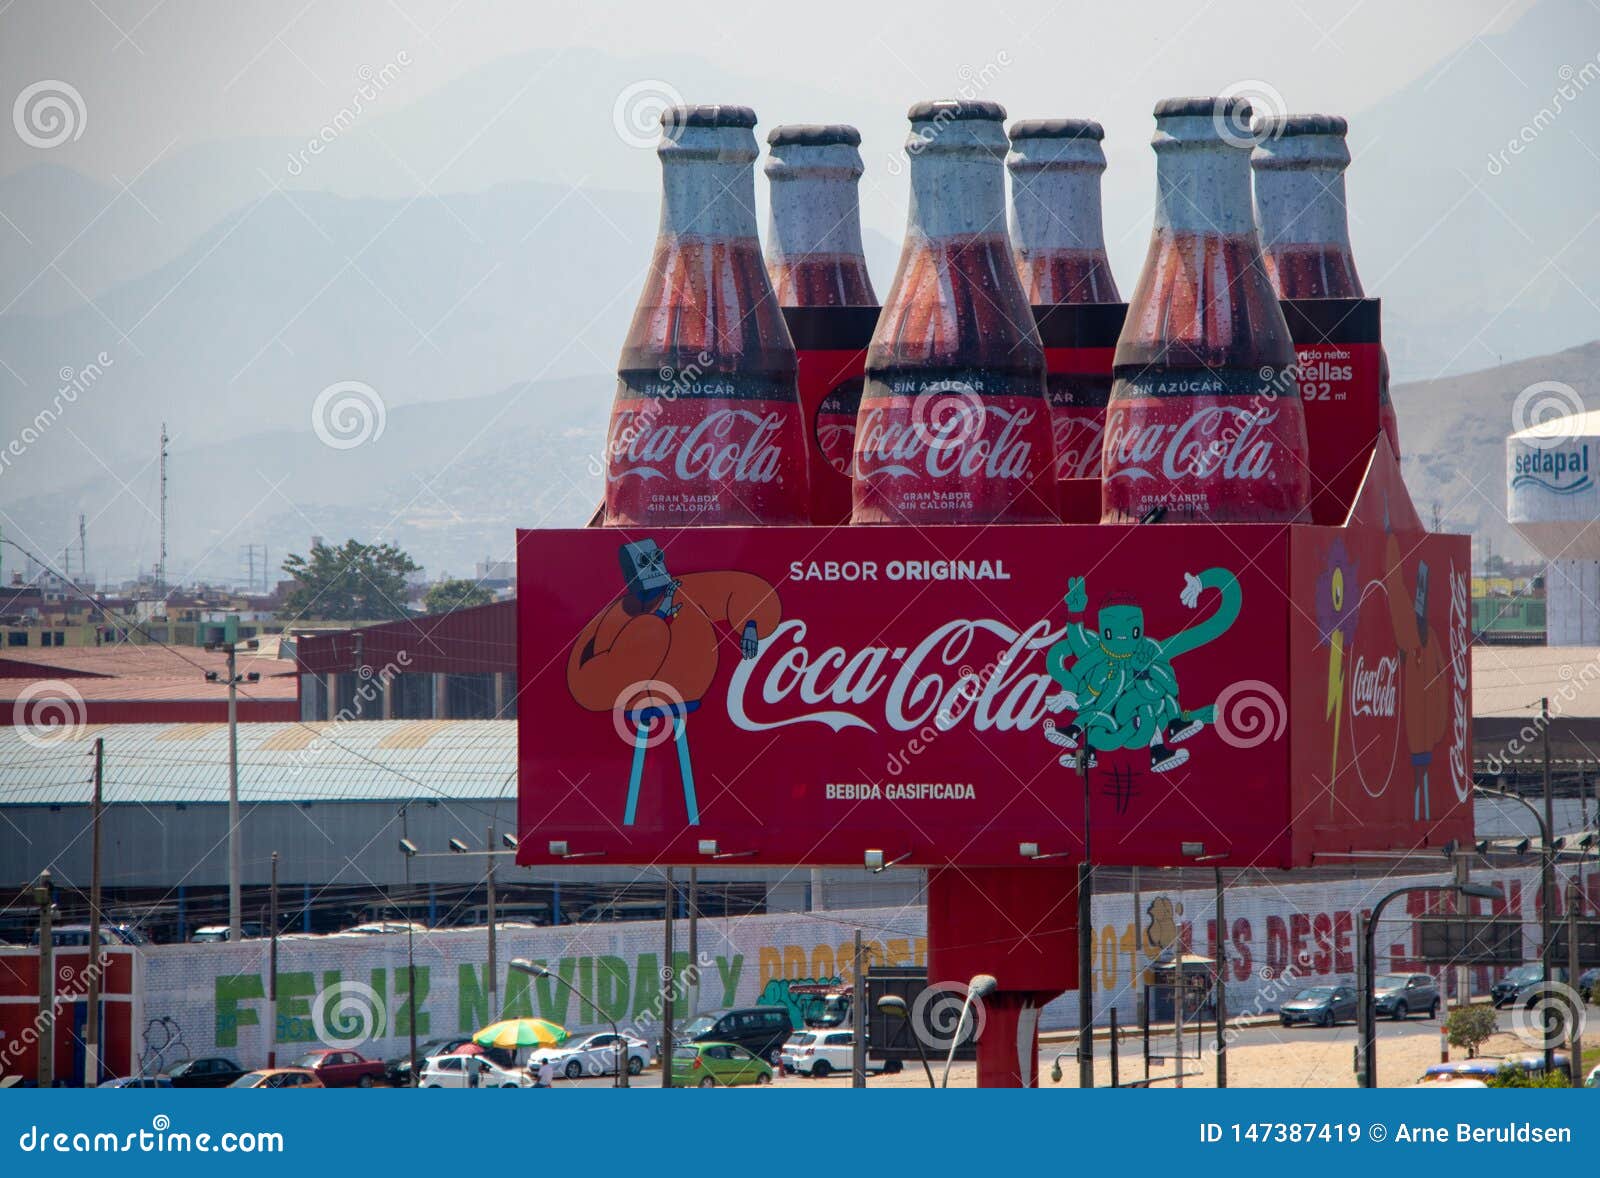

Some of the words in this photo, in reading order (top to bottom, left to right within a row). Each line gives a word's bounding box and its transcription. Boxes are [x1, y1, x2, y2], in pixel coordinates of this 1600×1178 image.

[1296, 362, 1352, 381] tellas
[894, 382, 915, 392] SIN
[1132, 385, 1153, 394] SIN
[1158, 381, 1223, 393] AZÚCAR
[1335, 392, 1346, 400] ml
[608, 409, 787, 483] Coca-Cola
[855, 408, 1036, 481] Coca-Cola
[1102, 406, 1280, 484] Coca-Cola
[1515, 444, 1589, 480] sedapal
[652, 495, 679, 503] GRAN
[683, 495, 718, 503] SABOR
[899, 501, 916, 510] SIN
[903, 493, 931, 501] GRAN
[935, 491, 971, 501] SABOR
[1141, 495, 1168, 503] GRAN
[1171, 493, 1208, 502] SABOR
[790, 561, 879, 581] SABOR
[886, 560, 1011, 581] ORIGINAL
[727, 619, 1068, 734] Coca-Cola
[1352, 656, 1399, 717] Coca-Cola
[826, 784, 881, 799] BEBIDA
[885, 784, 976, 799] GASIFICADA
[215, 965, 431, 1048] FELIZ
[715, 953, 744, 1008] Y
[1266, 907, 1372, 980] DESE
